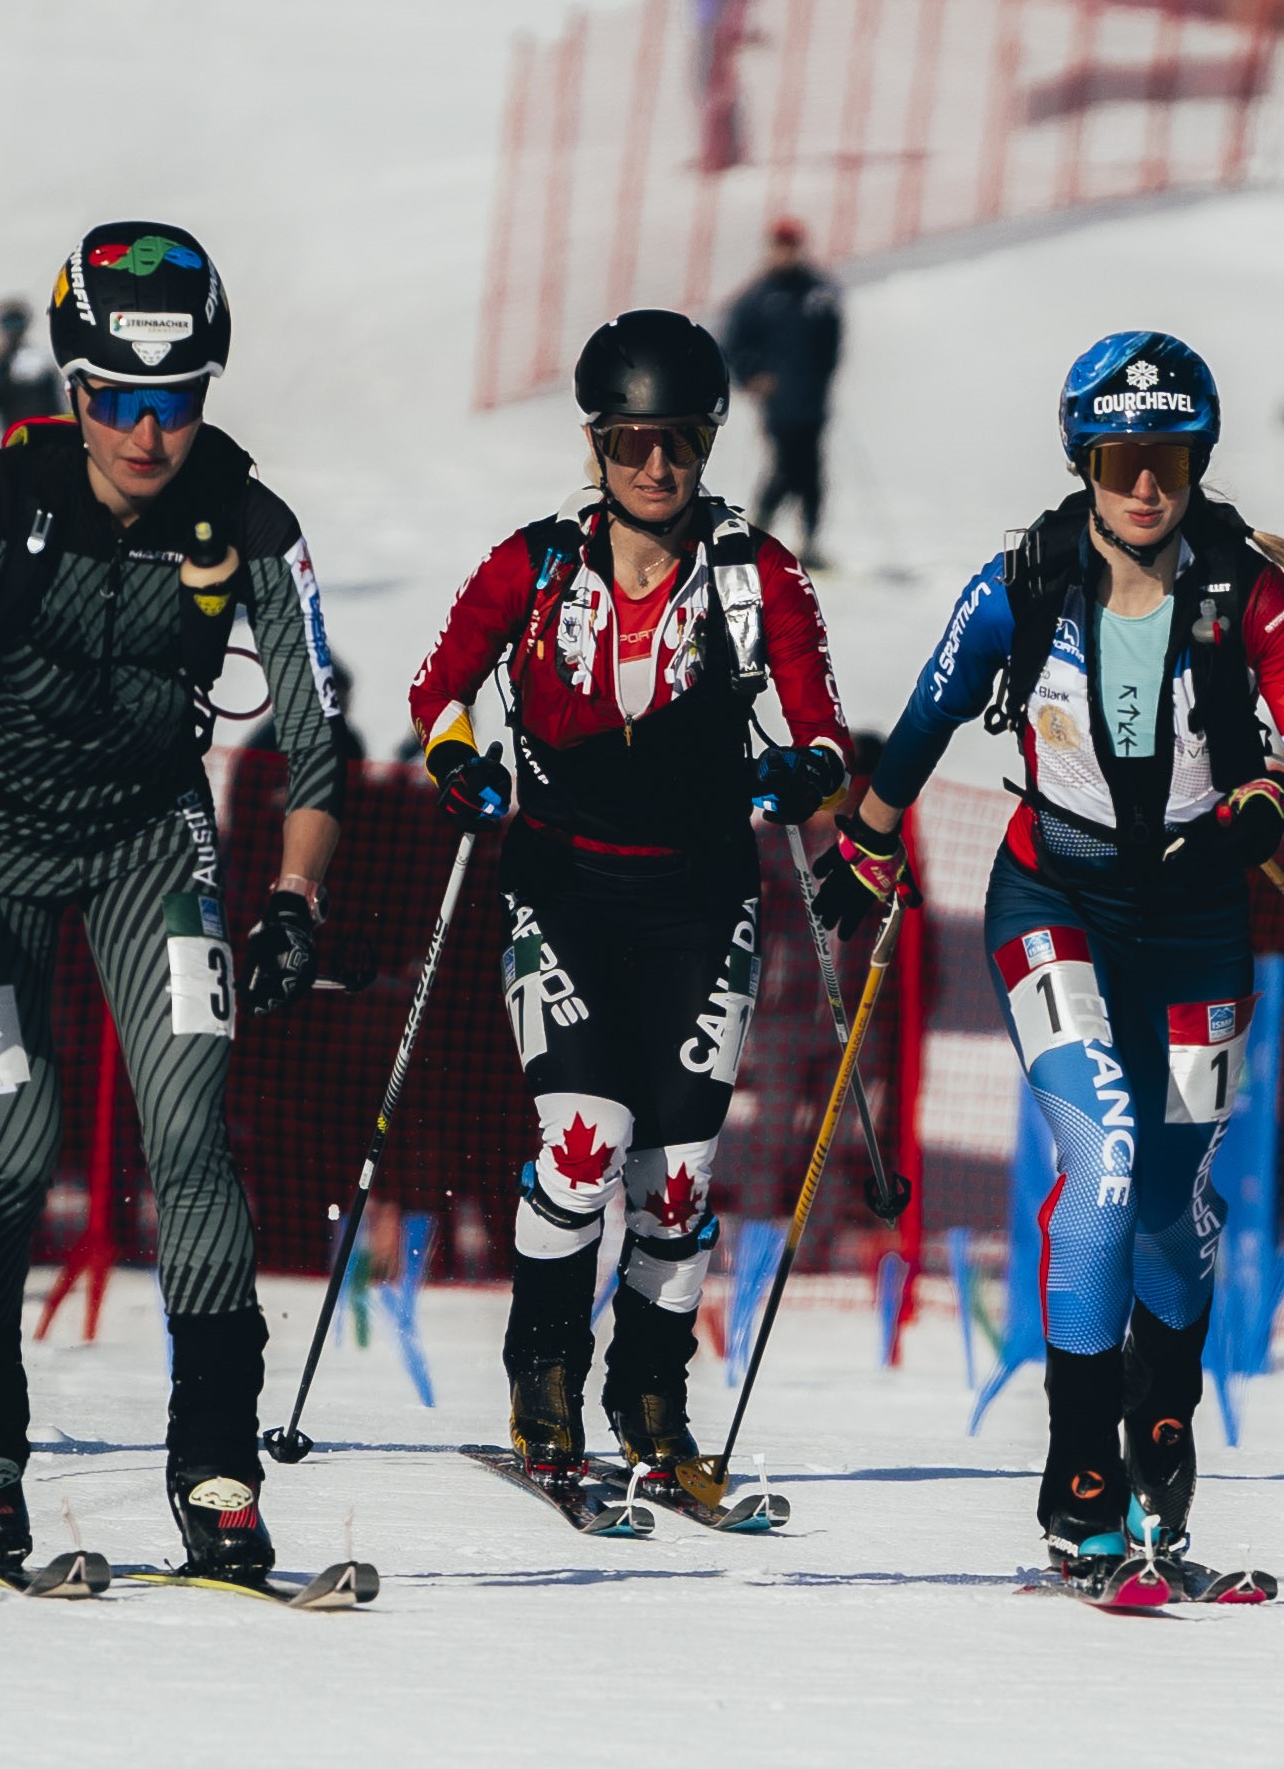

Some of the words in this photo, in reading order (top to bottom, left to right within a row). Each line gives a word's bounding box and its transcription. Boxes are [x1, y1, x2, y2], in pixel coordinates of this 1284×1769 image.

[1093, 392, 1195, 415] COURCHEVEL
[1039, 686, 1070, 703] Blank
[520, 735, 549, 785] CAMP
[208, 946, 231, 1022] 3
[1035, 971, 1062, 1034] 1
[1210, 1048, 1229, 1111] 1
